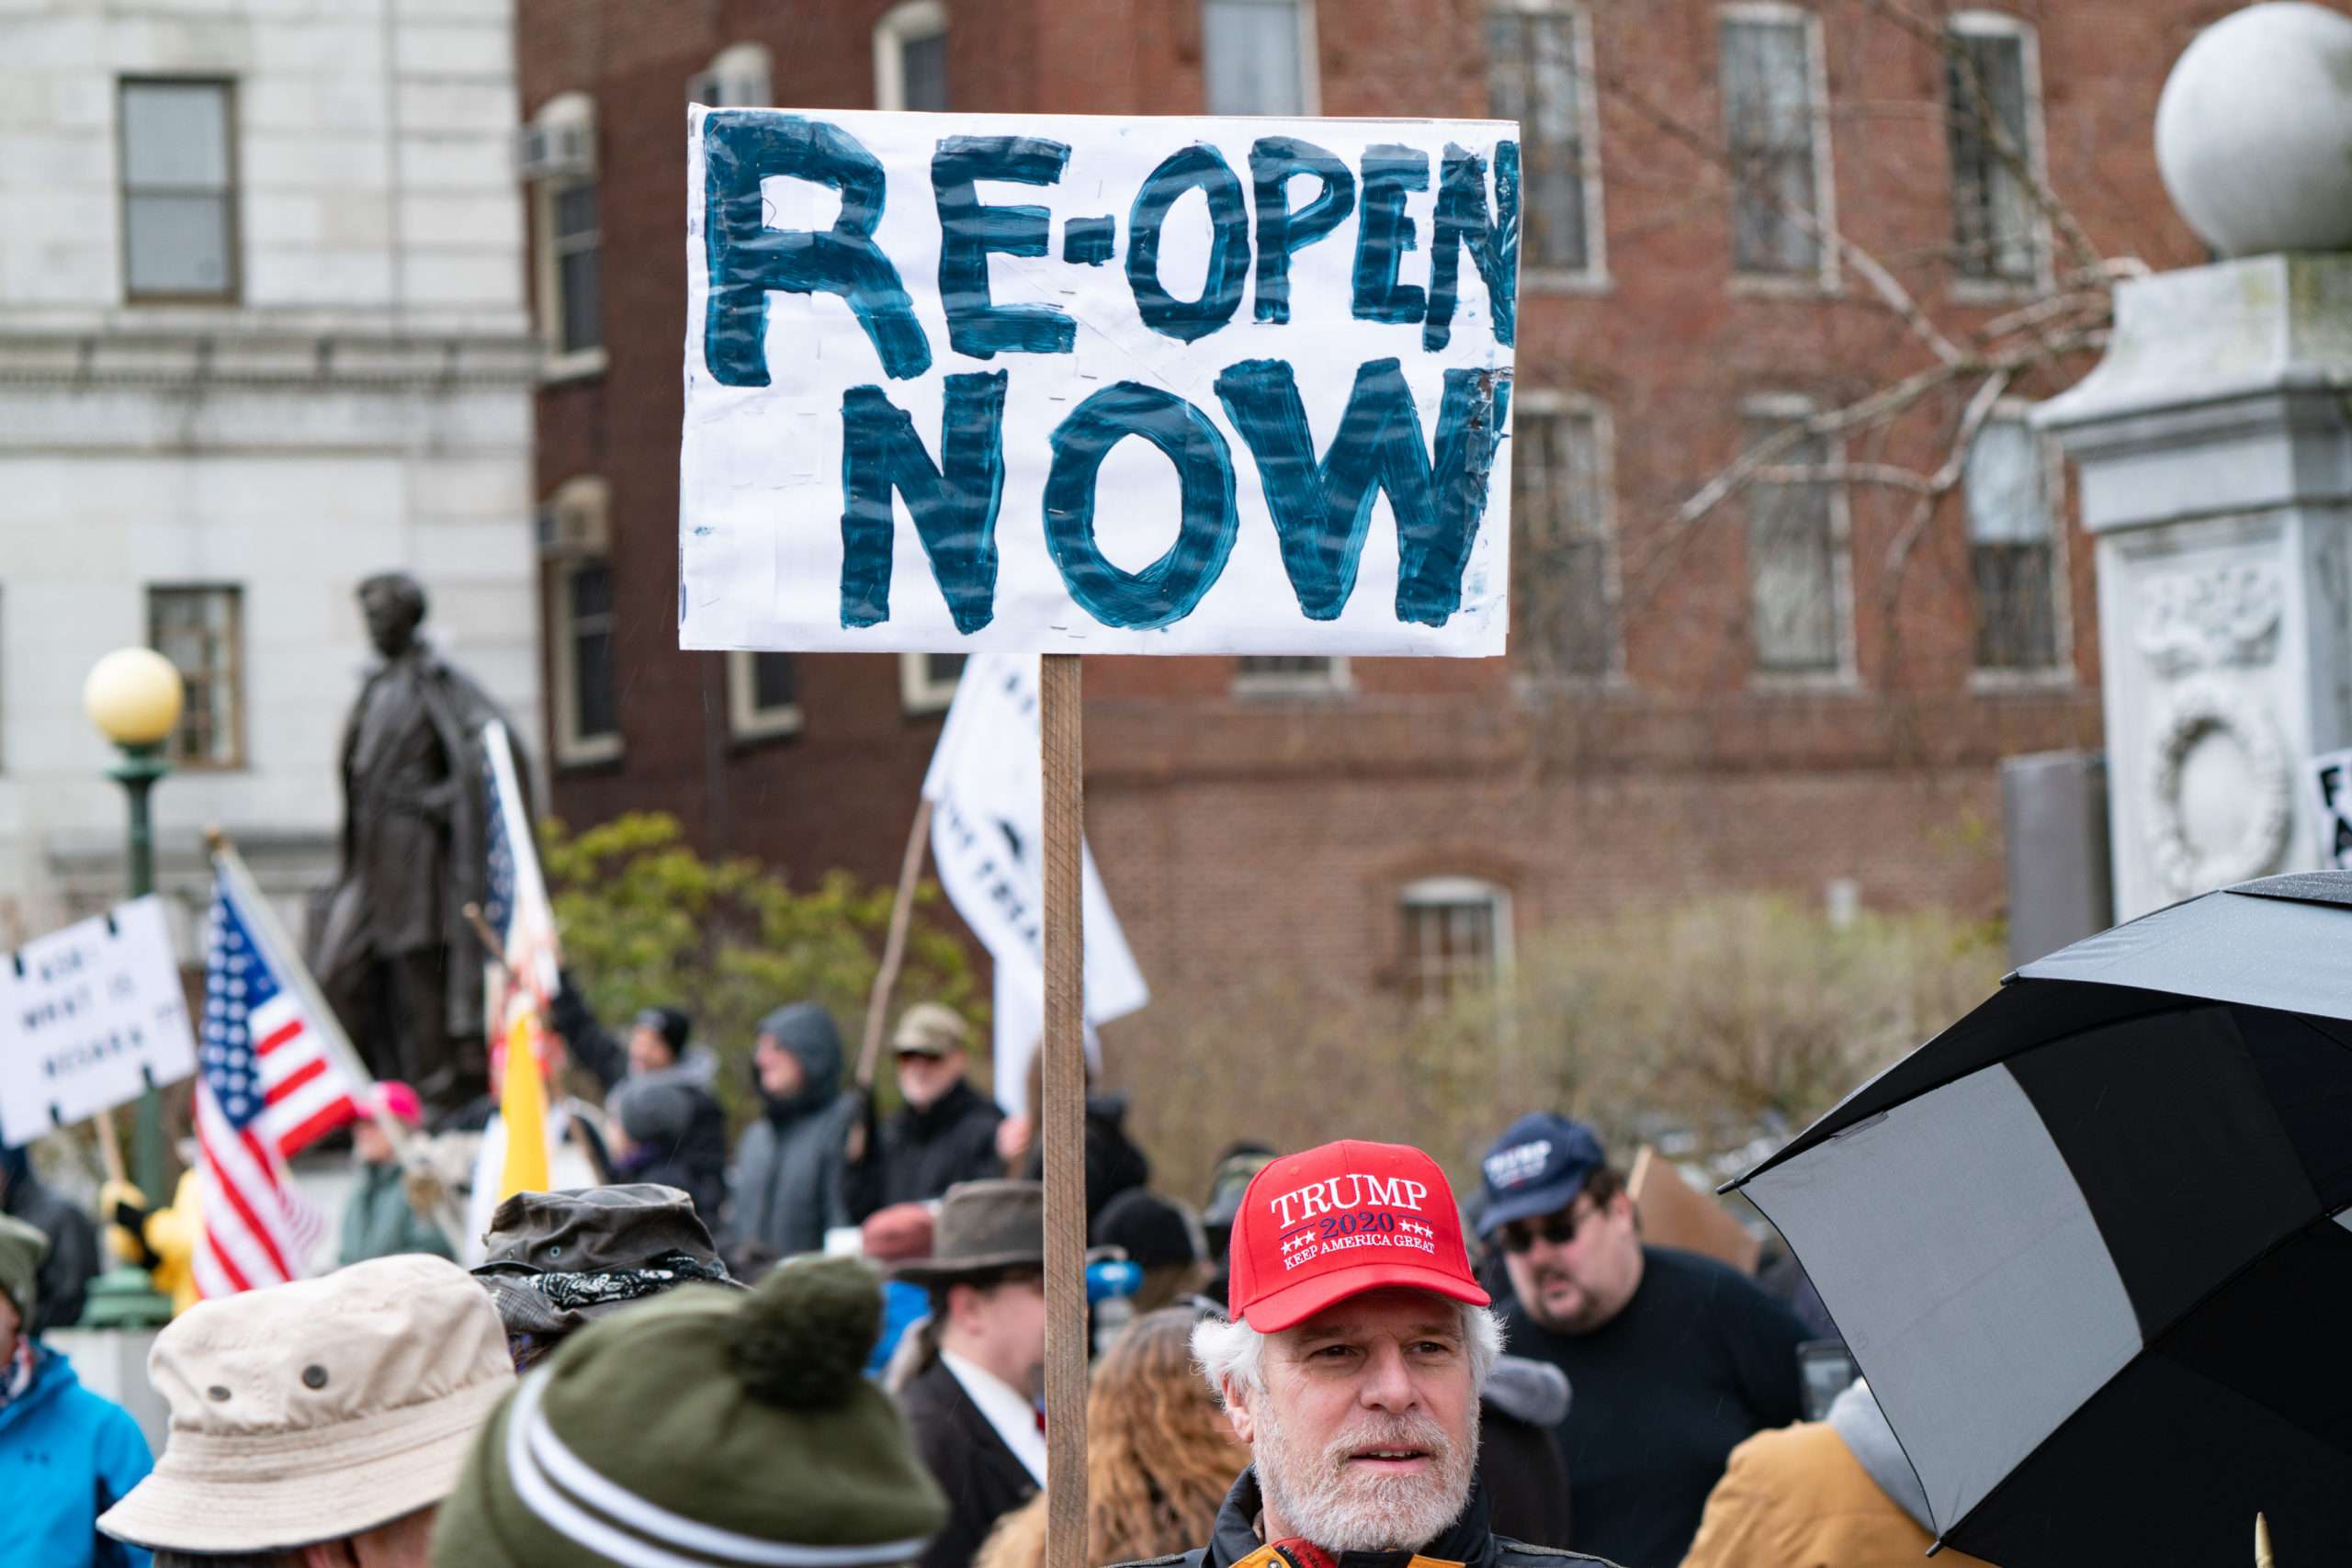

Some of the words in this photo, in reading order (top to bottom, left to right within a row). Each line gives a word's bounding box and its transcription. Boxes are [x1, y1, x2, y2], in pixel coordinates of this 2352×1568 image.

[703, 109, 1520, 388] RE-OPEN
[839, 357, 1513, 637] NOW
[1271, 1173, 1428, 1230] TRUMP
[1318, 1211, 1395, 1239] 2020
[1283, 1245, 1318, 1271] KEEP
[1319, 1233, 1393, 1255] AMERICA
[1392, 1235, 1436, 1256] GREAT
